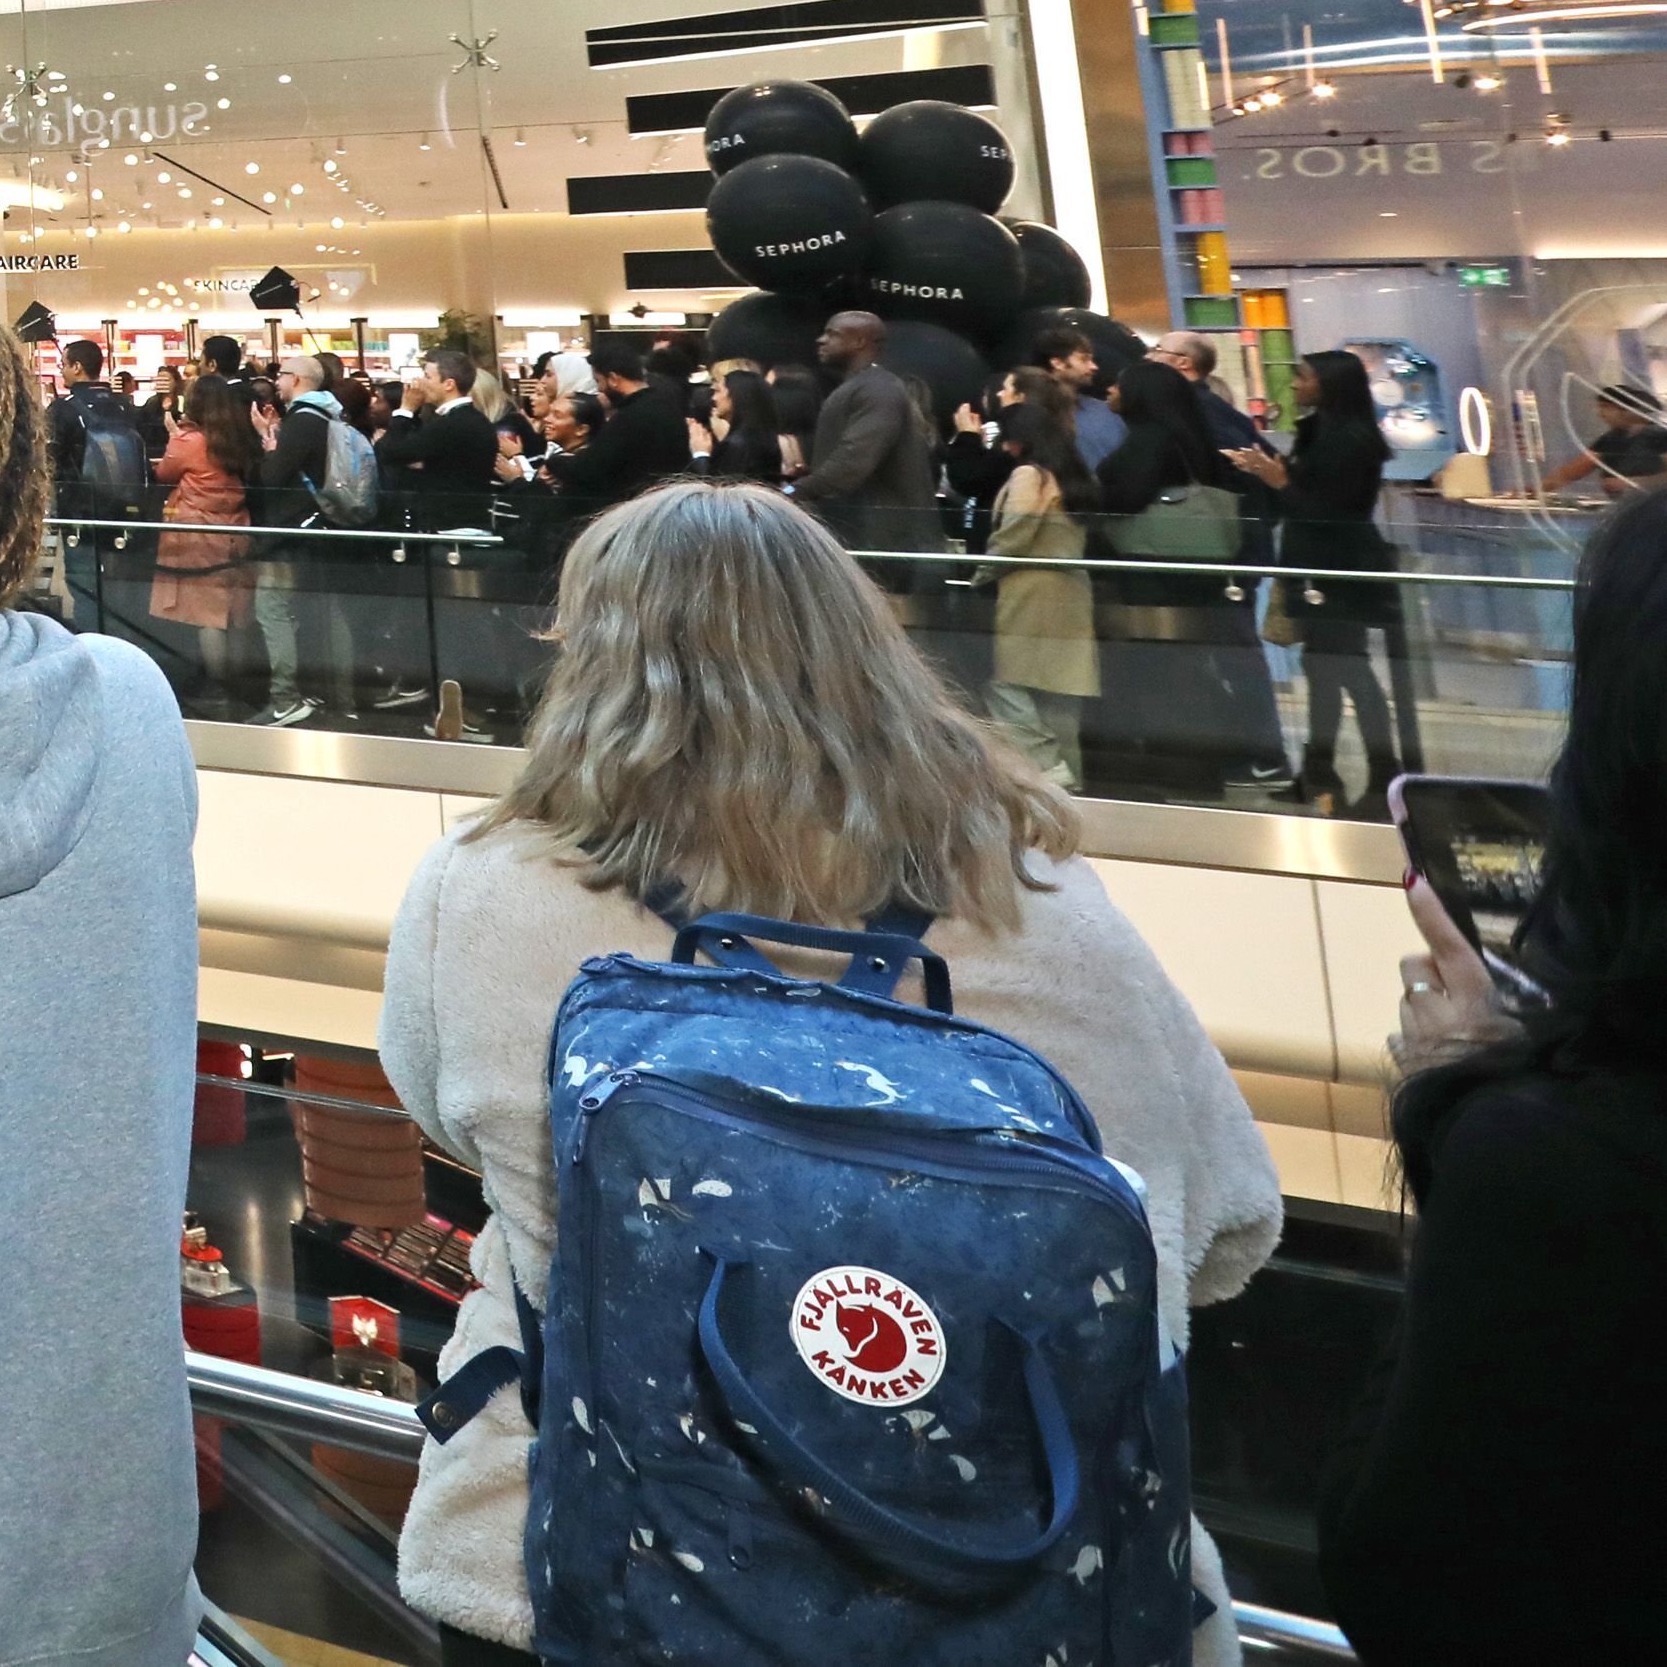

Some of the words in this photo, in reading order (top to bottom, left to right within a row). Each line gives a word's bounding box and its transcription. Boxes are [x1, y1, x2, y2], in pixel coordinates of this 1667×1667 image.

[755, 230, 847, 258] SEPHORA
[194, 279, 258, 292] SKINCAR
[870, 277, 964, 300] SEPHORA
